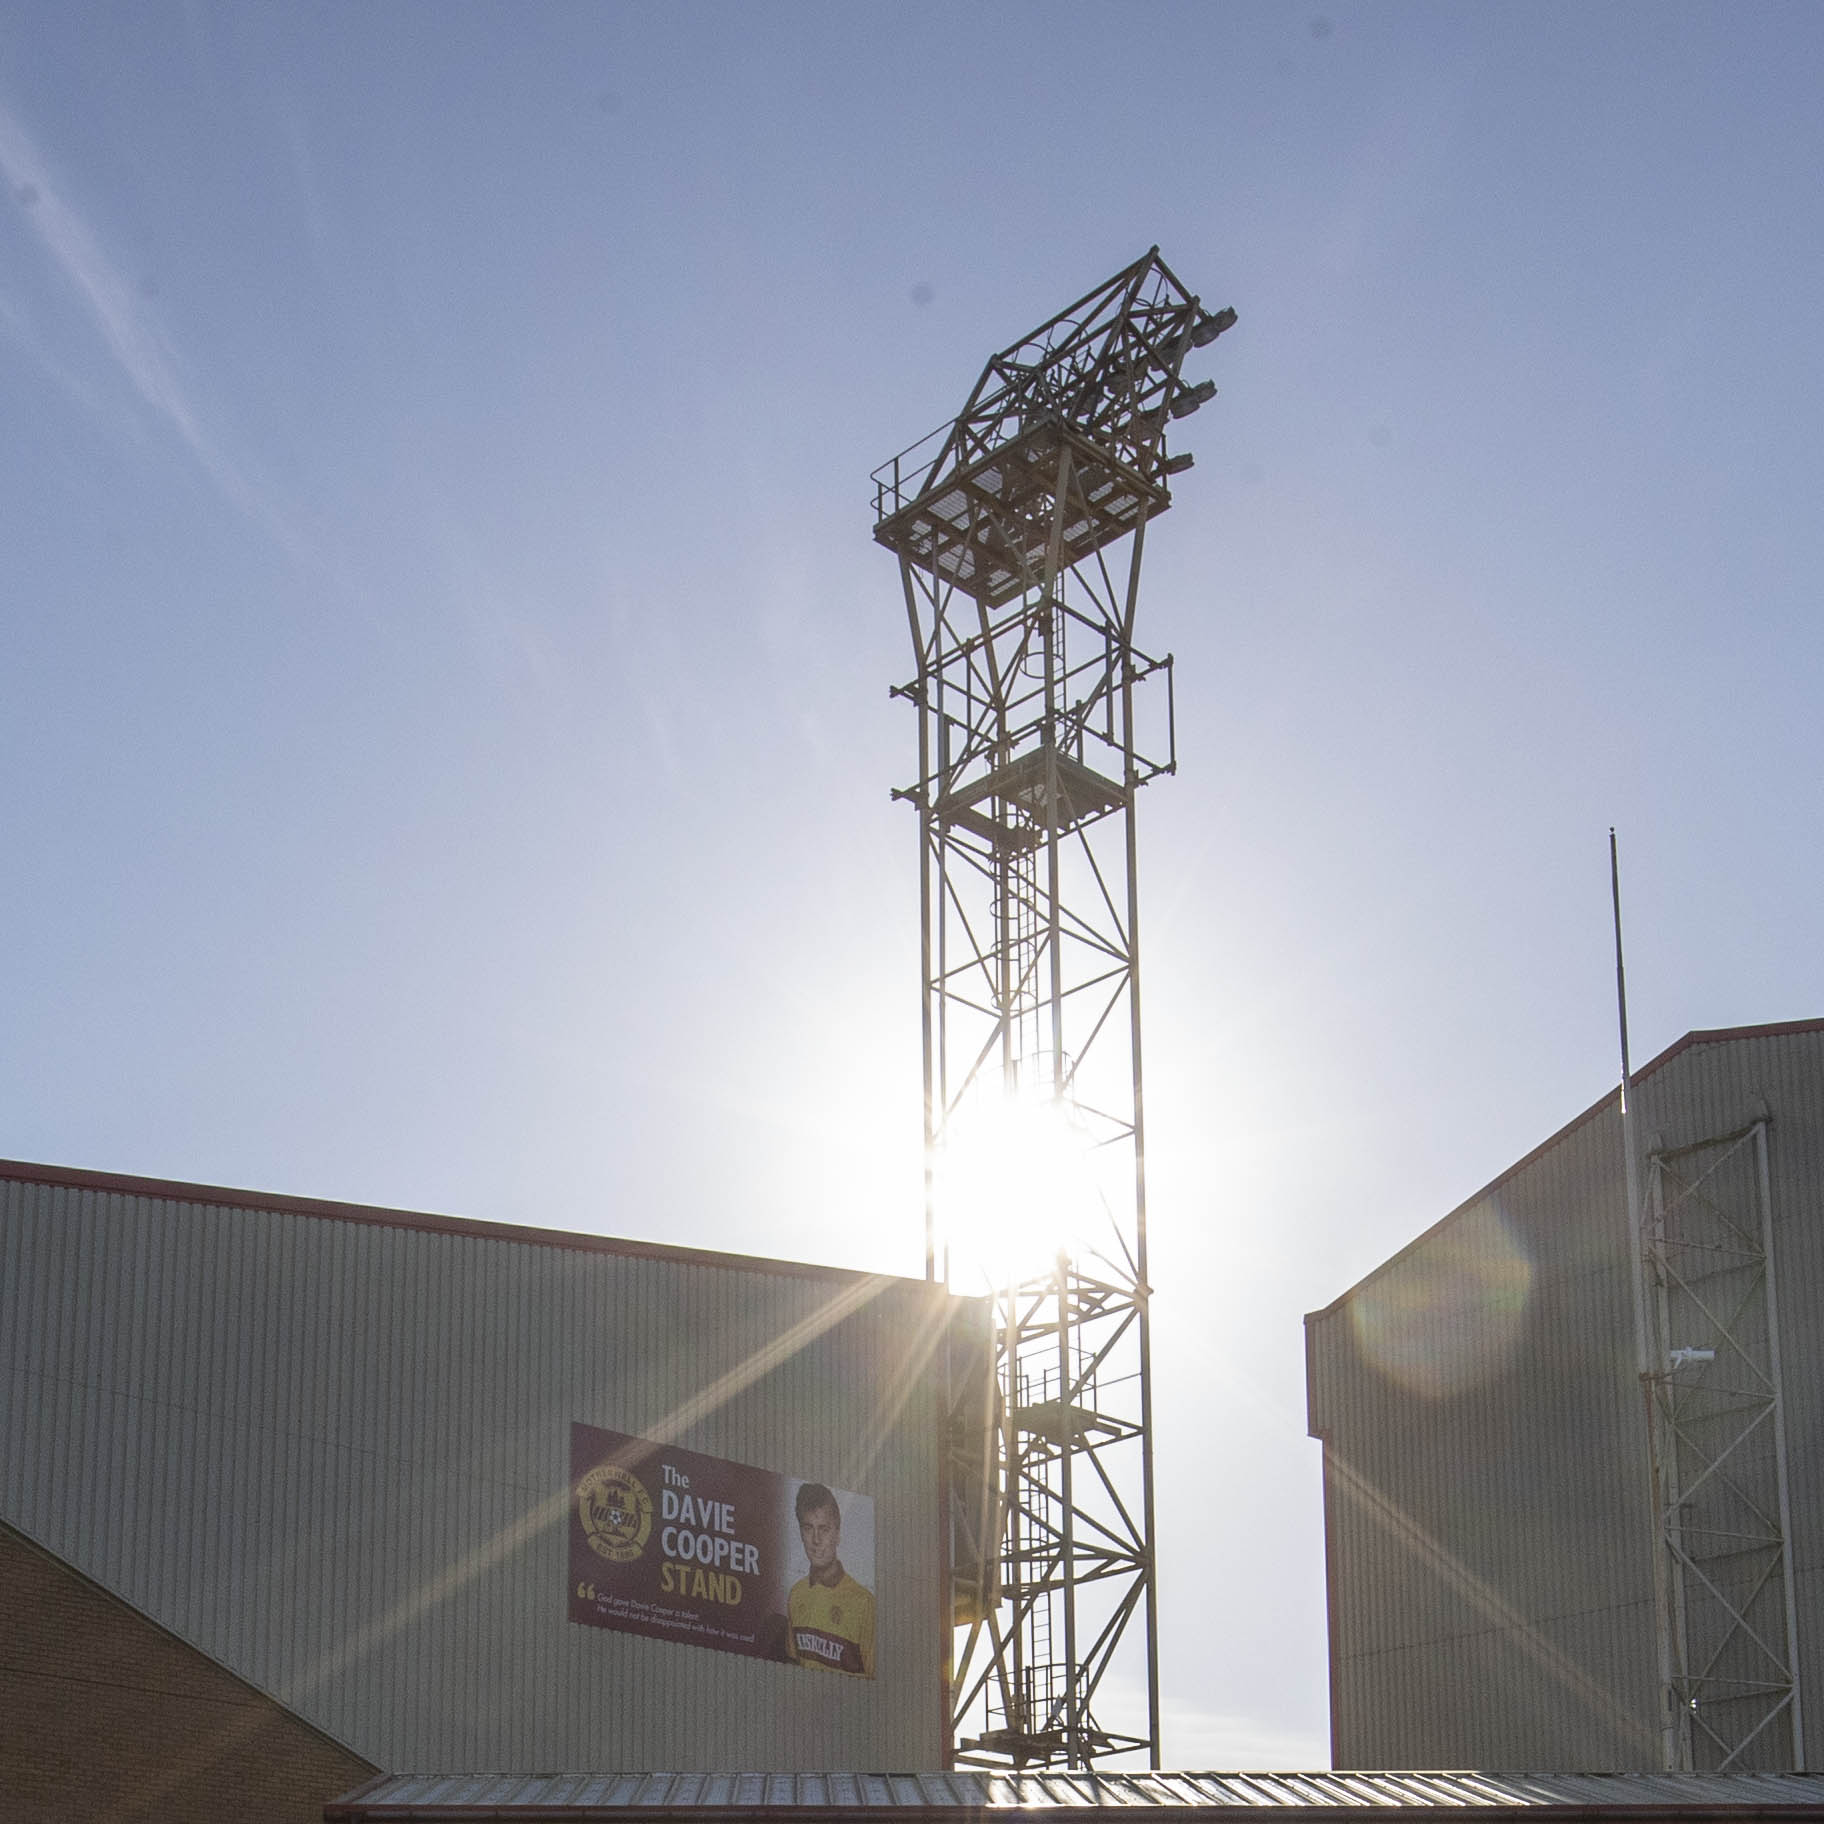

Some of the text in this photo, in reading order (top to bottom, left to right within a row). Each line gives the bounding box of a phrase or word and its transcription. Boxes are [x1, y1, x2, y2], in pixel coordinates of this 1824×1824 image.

[662, 1464, 689, 1488] The
[661, 1488, 735, 1535] DAVIE
[661, 1526, 760, 1575] COOPER
[661, 1561, 743, 1606] STAND
